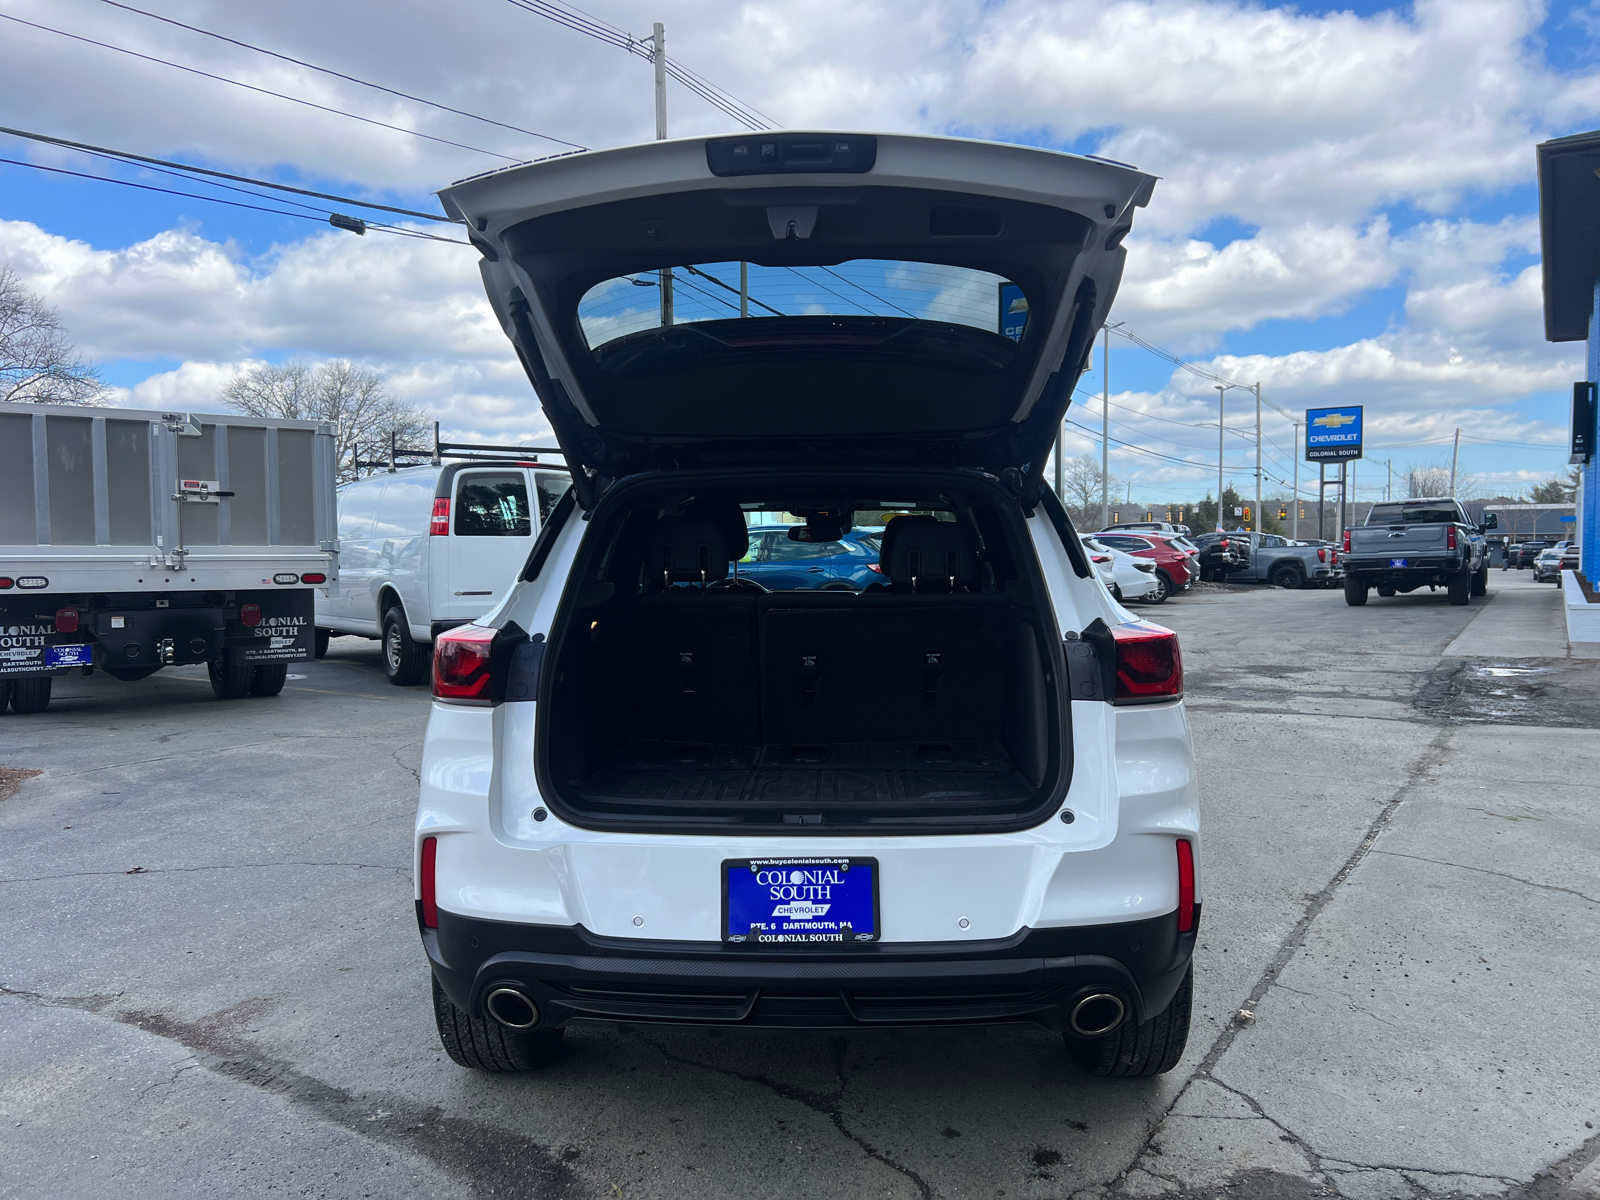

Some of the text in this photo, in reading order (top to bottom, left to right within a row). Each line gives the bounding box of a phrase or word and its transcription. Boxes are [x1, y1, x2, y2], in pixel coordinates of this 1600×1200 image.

[1310, 433, 1358, 442] CHEVROLET
[255, 617, 307, 627] LONIAL
[254, 627, 298, 637] SOUTH
[756, 870, 845, 885] COLONIAL
[770, 886, 831, 900] SOUTH
[778, 906, 825, 914] CHEVROLET
[783, 922, 838, 930] DARTMOUTH,
[758, 934, 843, 942] COLONIAL SOUTH
